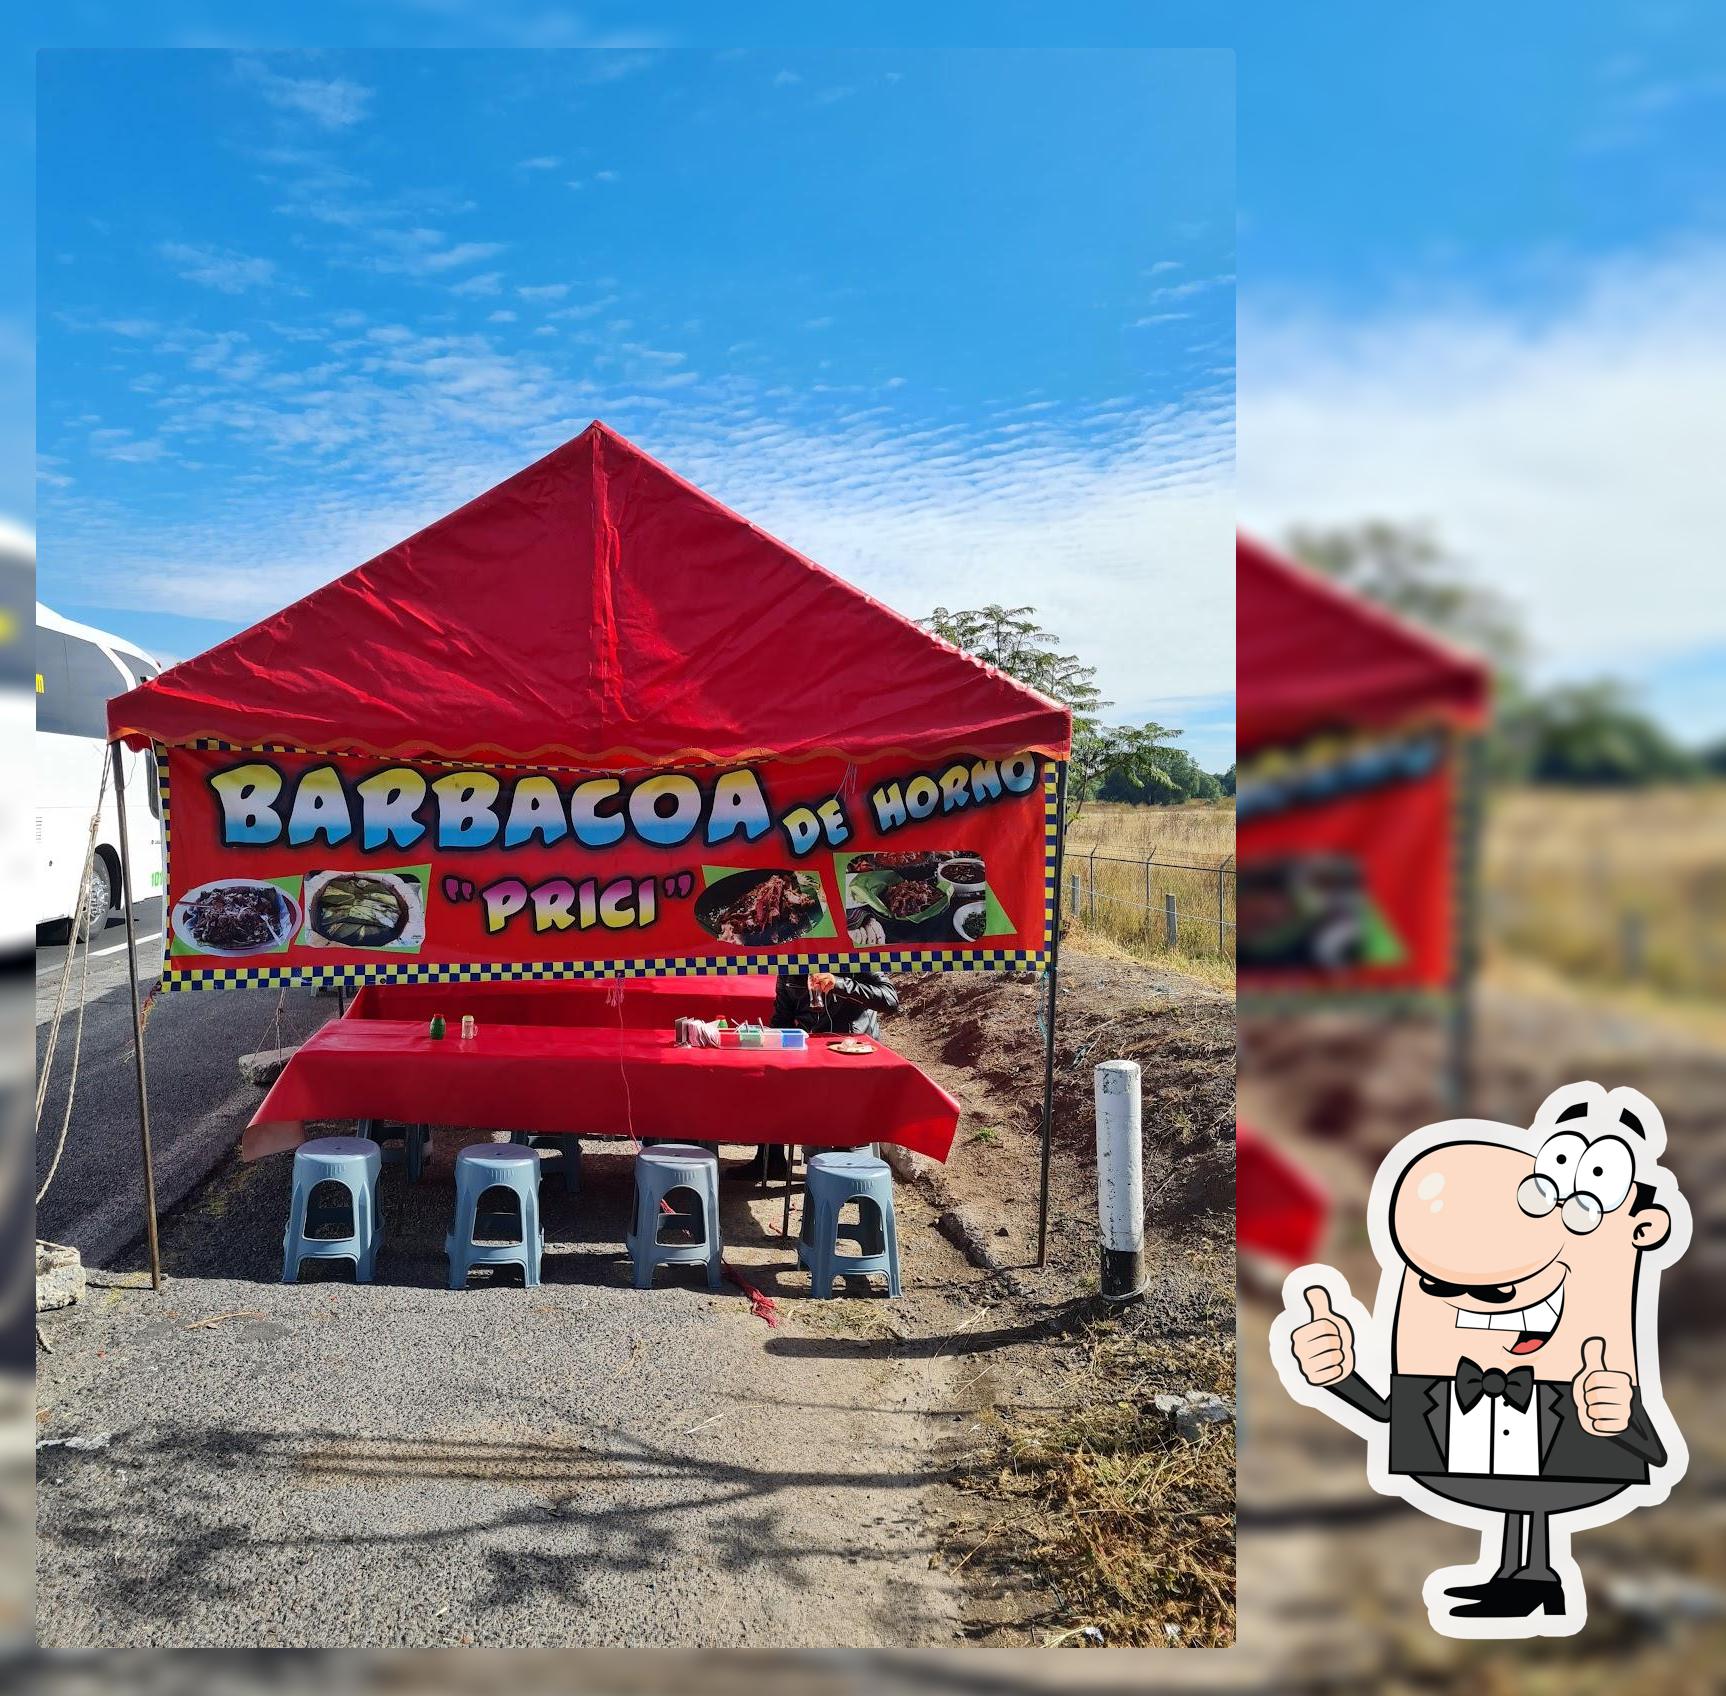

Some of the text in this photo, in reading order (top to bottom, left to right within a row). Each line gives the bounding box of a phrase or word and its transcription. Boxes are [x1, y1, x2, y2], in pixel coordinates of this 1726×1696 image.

[208, 750, 1037, 856] BARBACOA DE HORNO
